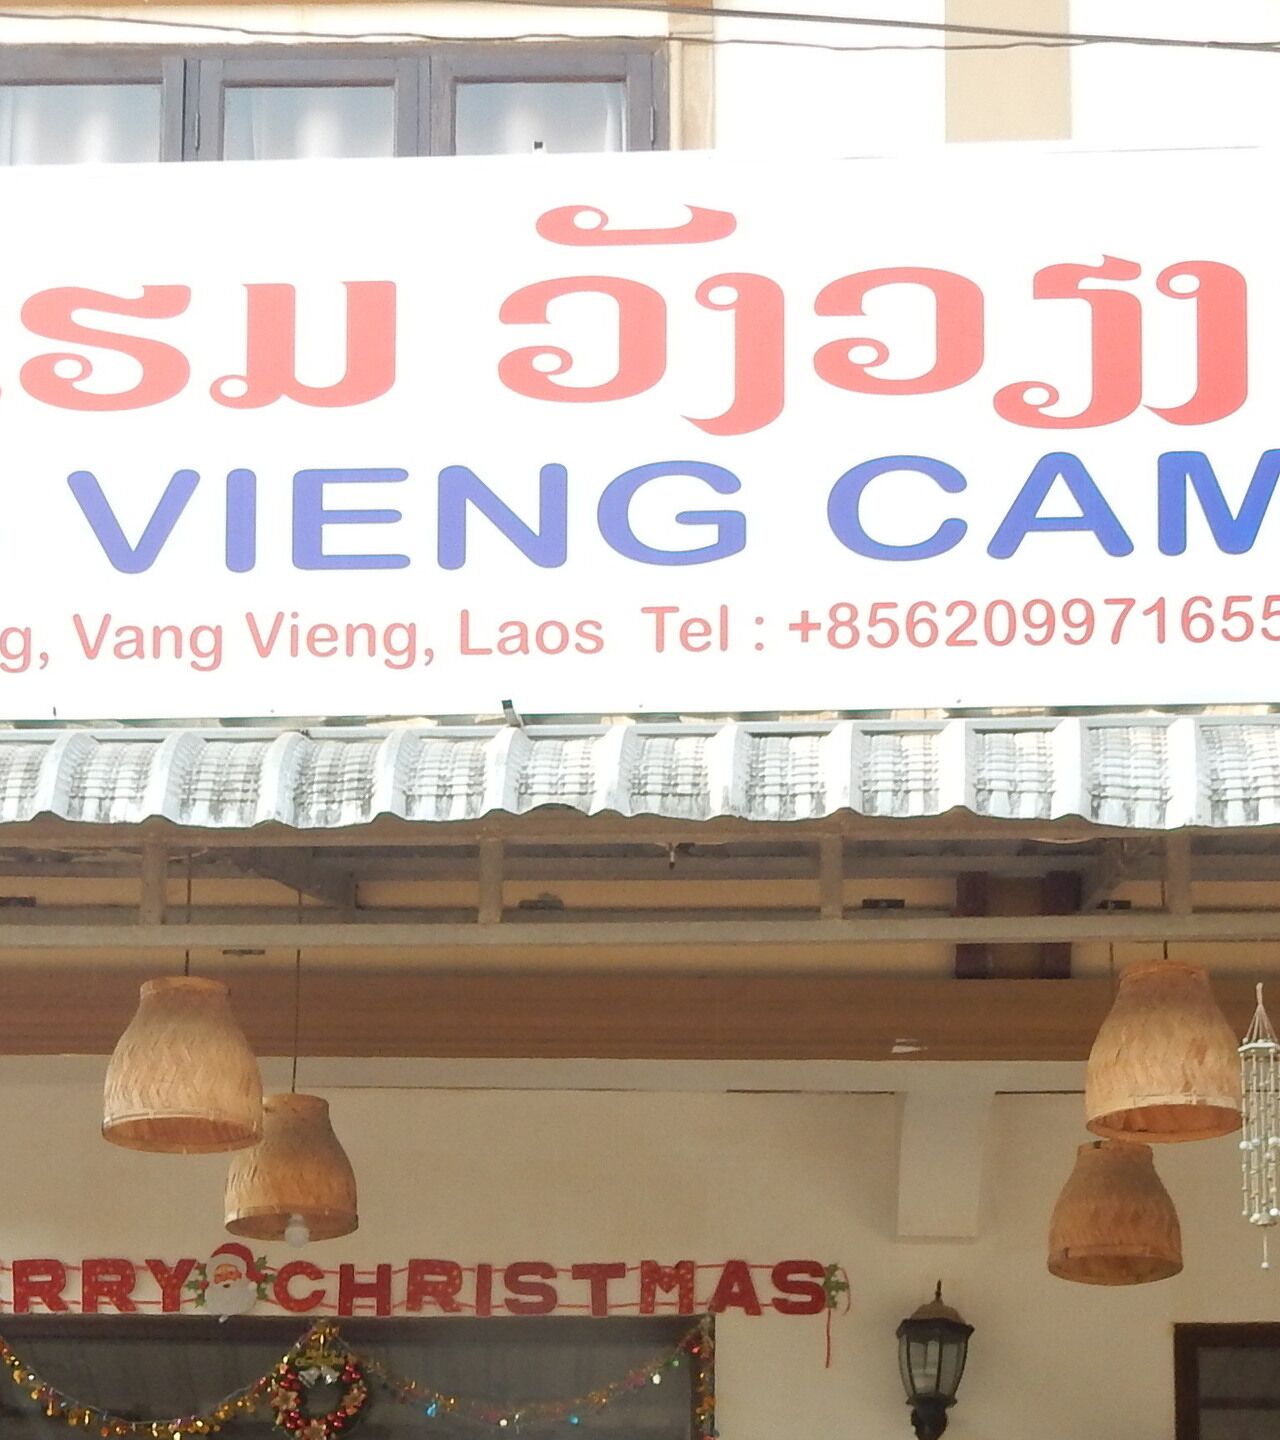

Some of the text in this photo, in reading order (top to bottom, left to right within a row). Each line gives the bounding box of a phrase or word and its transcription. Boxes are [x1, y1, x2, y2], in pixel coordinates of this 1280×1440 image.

[66, 460, 748, 574] VIENG
[72, 614, 223, 672] Vang
[245, 612, 435, 671] Vieng,
[459, 610, 605, 657] Laos
[641, 605, 729, 652] Tel
[268, 1257, 828, 1318] CHRISTMAS
